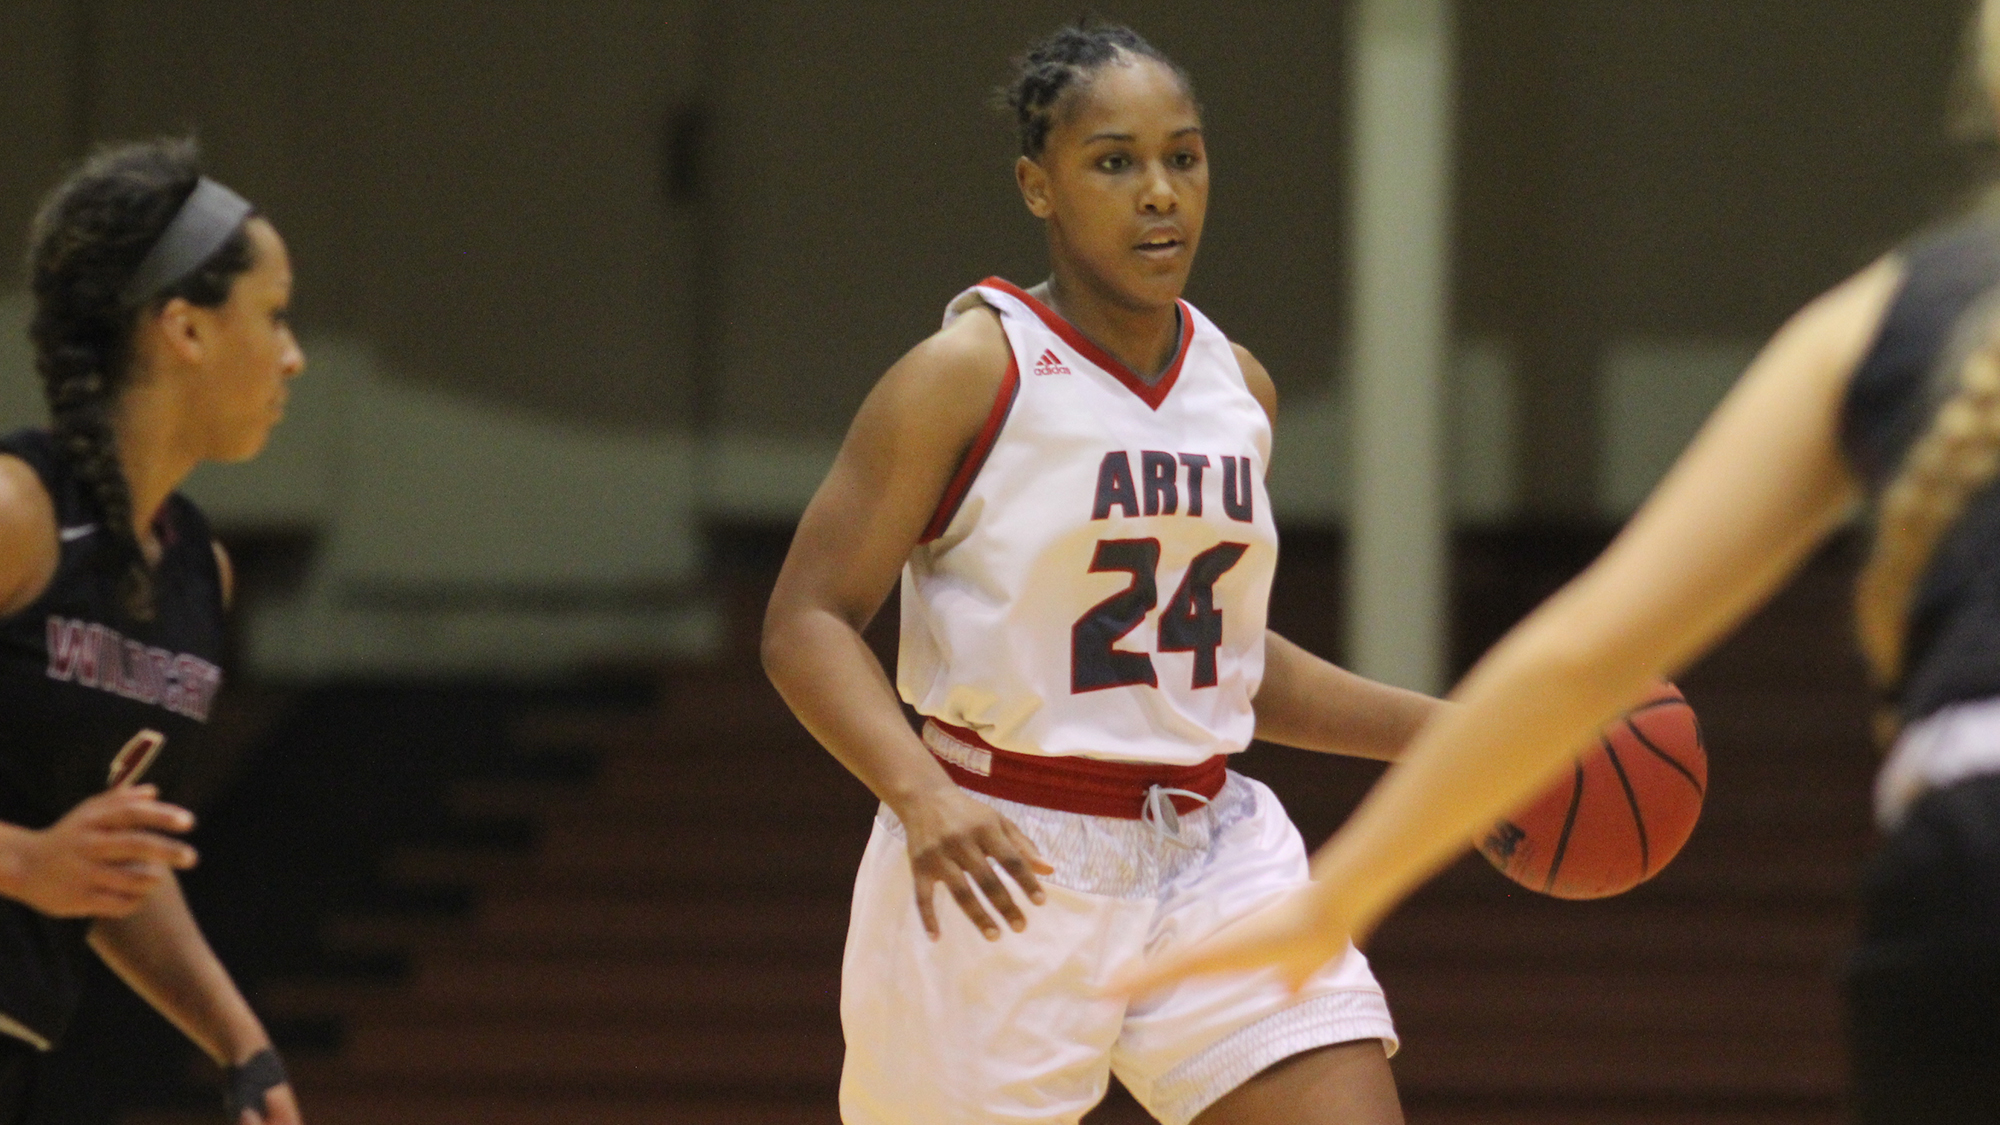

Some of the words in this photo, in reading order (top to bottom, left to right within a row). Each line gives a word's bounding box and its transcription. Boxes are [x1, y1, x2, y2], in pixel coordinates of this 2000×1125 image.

[1034, 364, 1072, 376] adidas
[1090, 449, 1211, 521] ART
[1219, 455, 1253, 523] U
[1070, 537, 1251, 695] 24
